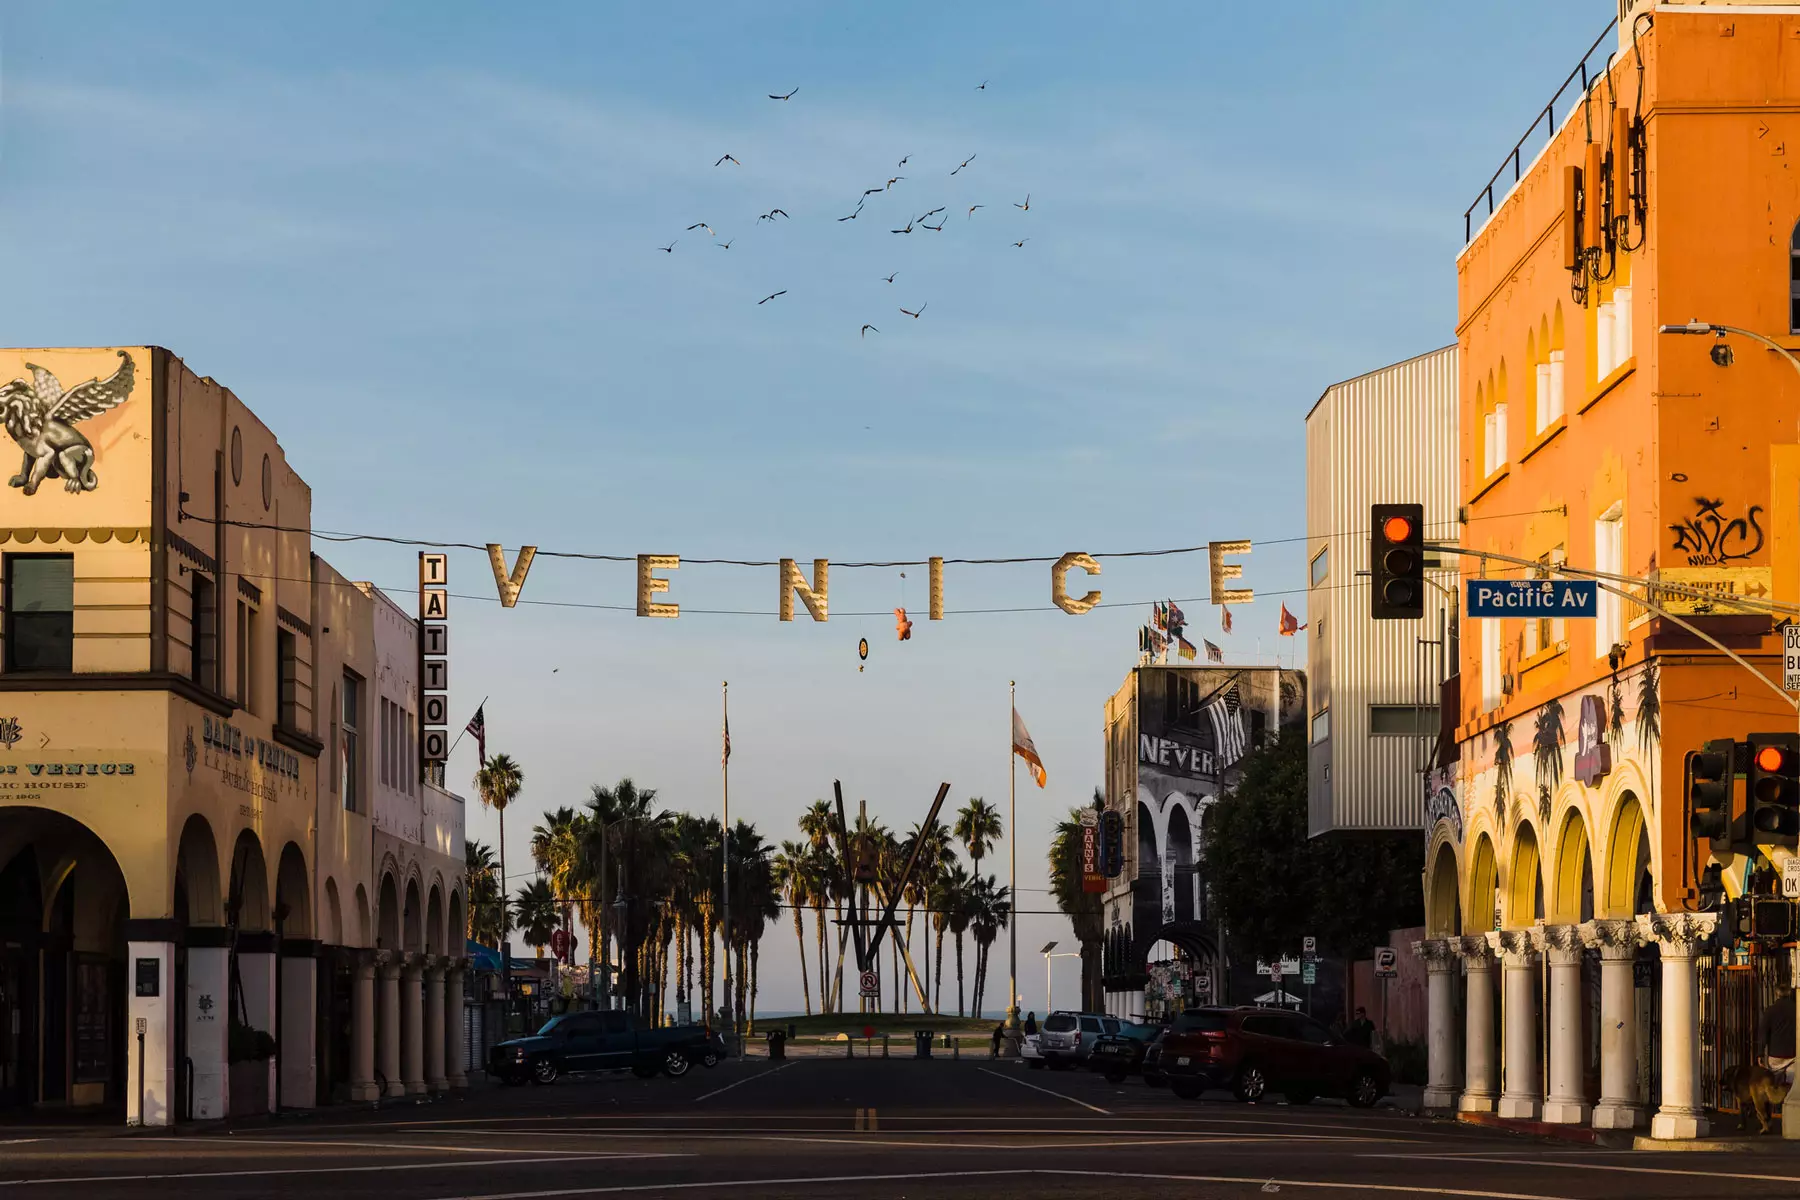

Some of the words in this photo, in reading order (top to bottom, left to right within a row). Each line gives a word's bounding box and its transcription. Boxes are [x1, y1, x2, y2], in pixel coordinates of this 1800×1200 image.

[486, 540, 1254, 622] VENICE
[1478, 587, 1554, 607] Pacific
[1562, 588, 1588, 607] Av
[426, 558, 443, 756] TATTOO
[26, 763, 135, 776] VENICE
[1084, 828, 1093, 872] DANNYS
[1785, 878, 1798, 892] OK
